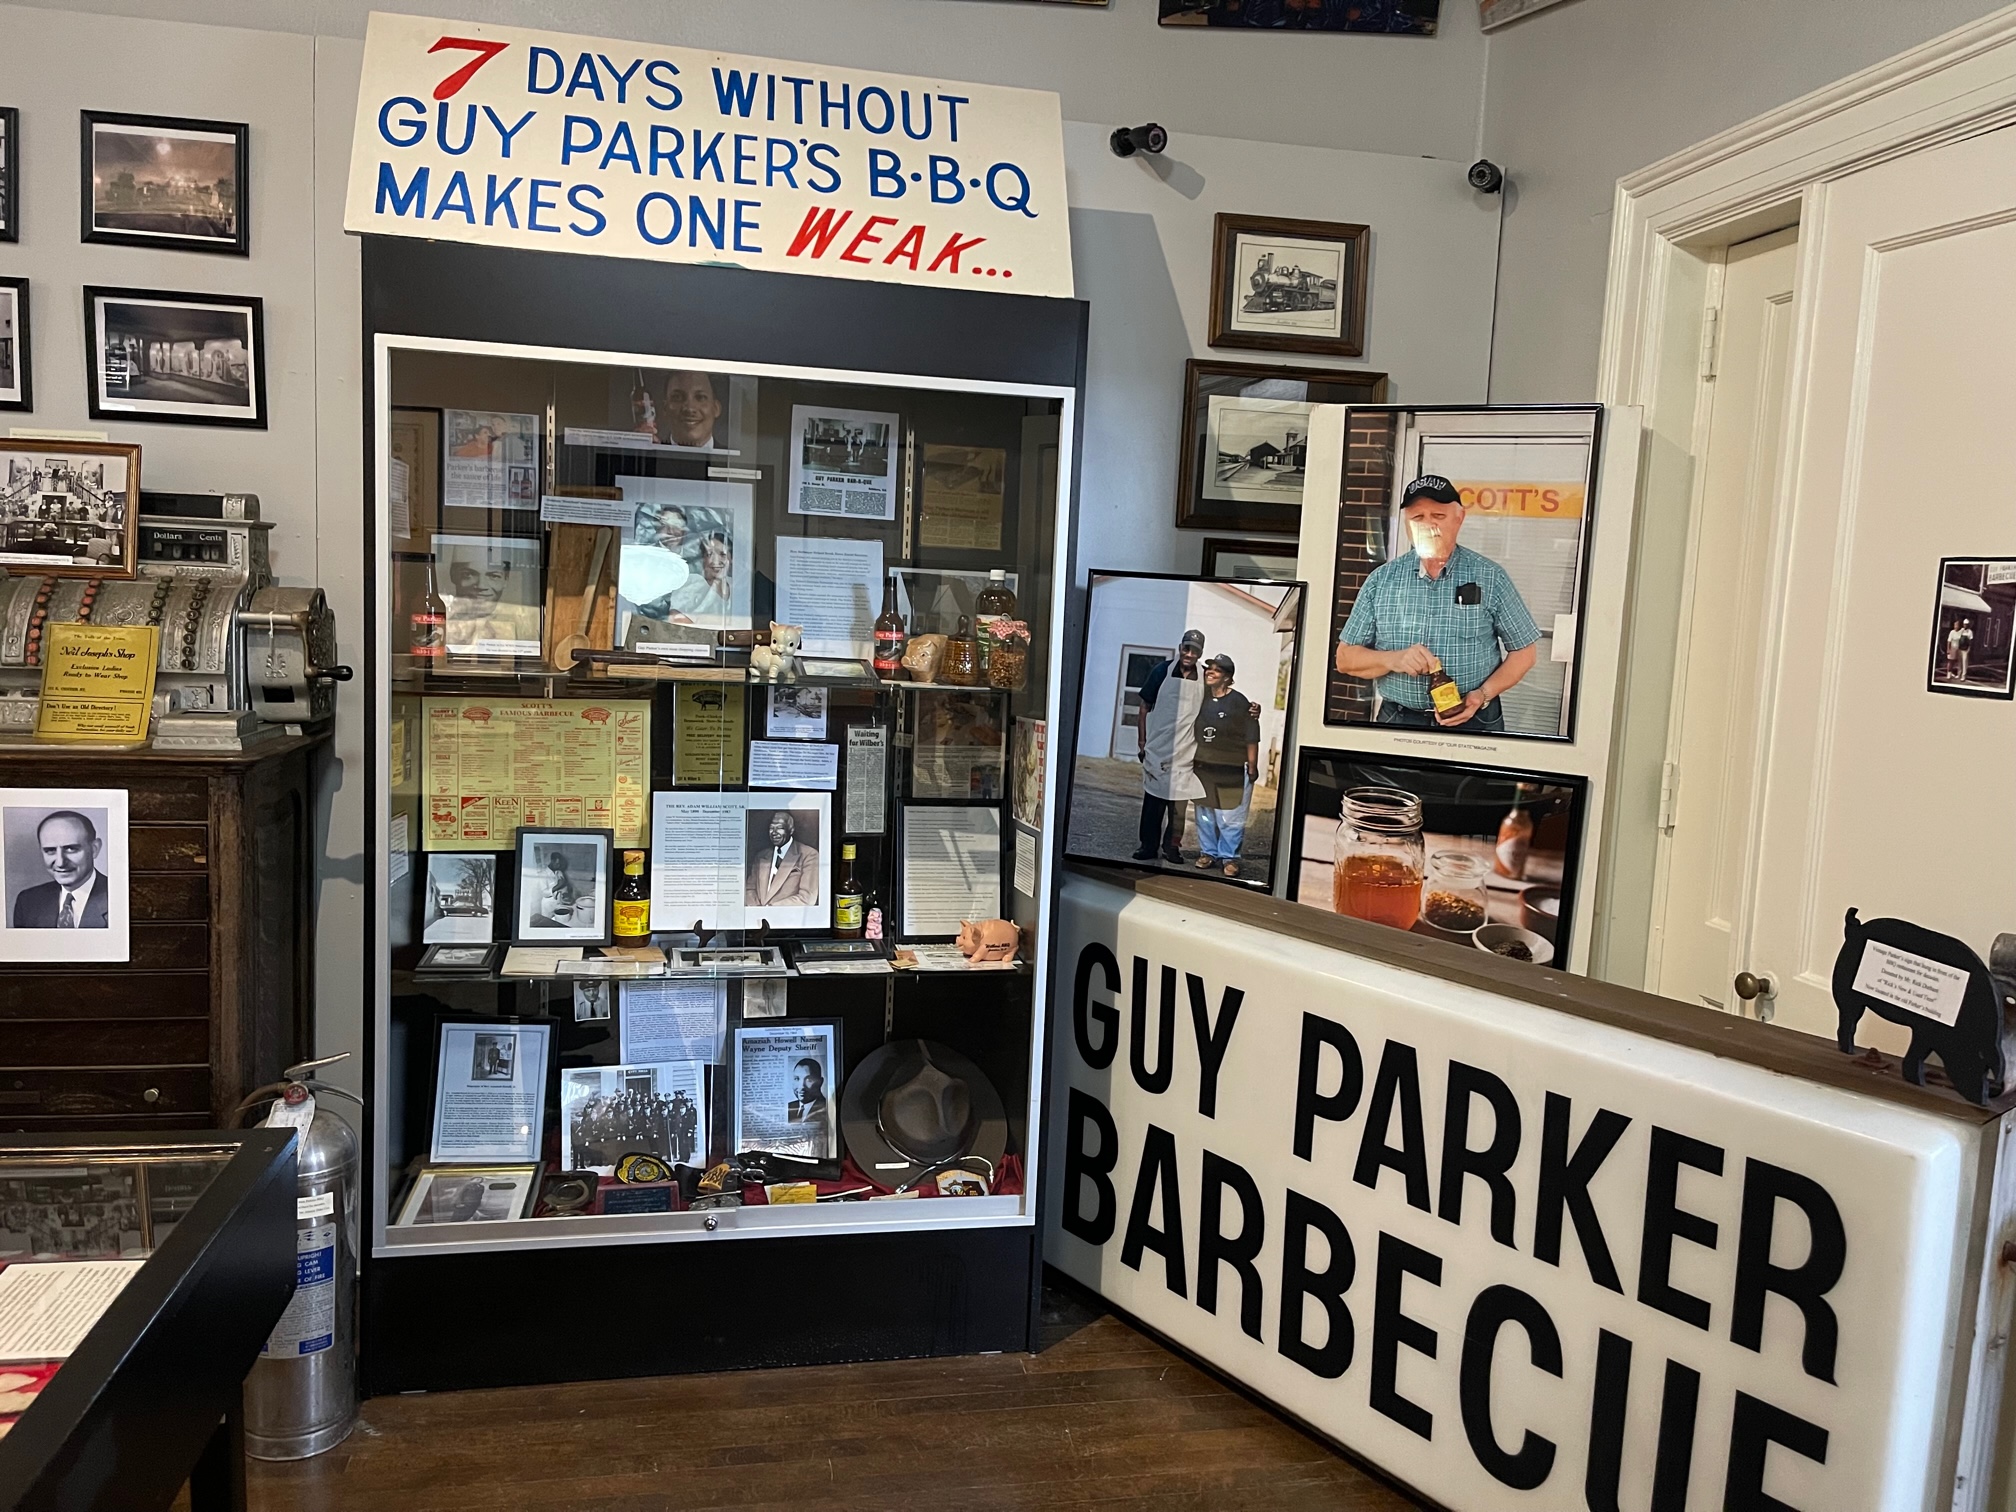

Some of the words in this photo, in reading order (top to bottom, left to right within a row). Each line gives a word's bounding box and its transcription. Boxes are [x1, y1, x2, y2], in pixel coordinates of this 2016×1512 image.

[428, 36, 510, 100] 7
[529, 48, 682, 113] DAYS
[713, 67, 970, 144] WITHOUT
[378, 96, 537, 159] GUY
[562, 115, 841, 194] PARKER'S
[375, 161, 607, 237] MAKES
[637, 191, 763, 253] ONE
[1460, 487, 1559, 512] COTT'S
[114, 648, 136, 660] Shop
[854, 730, 879, 739] Waiting
[742, 1045, 765, 1053] Wayne
[1071, 940, 1245, 1121] GUY
[1293, 1010, 1848, 1387] PARKER
[1061, 1087, 1829, 1512] BARBECUE
